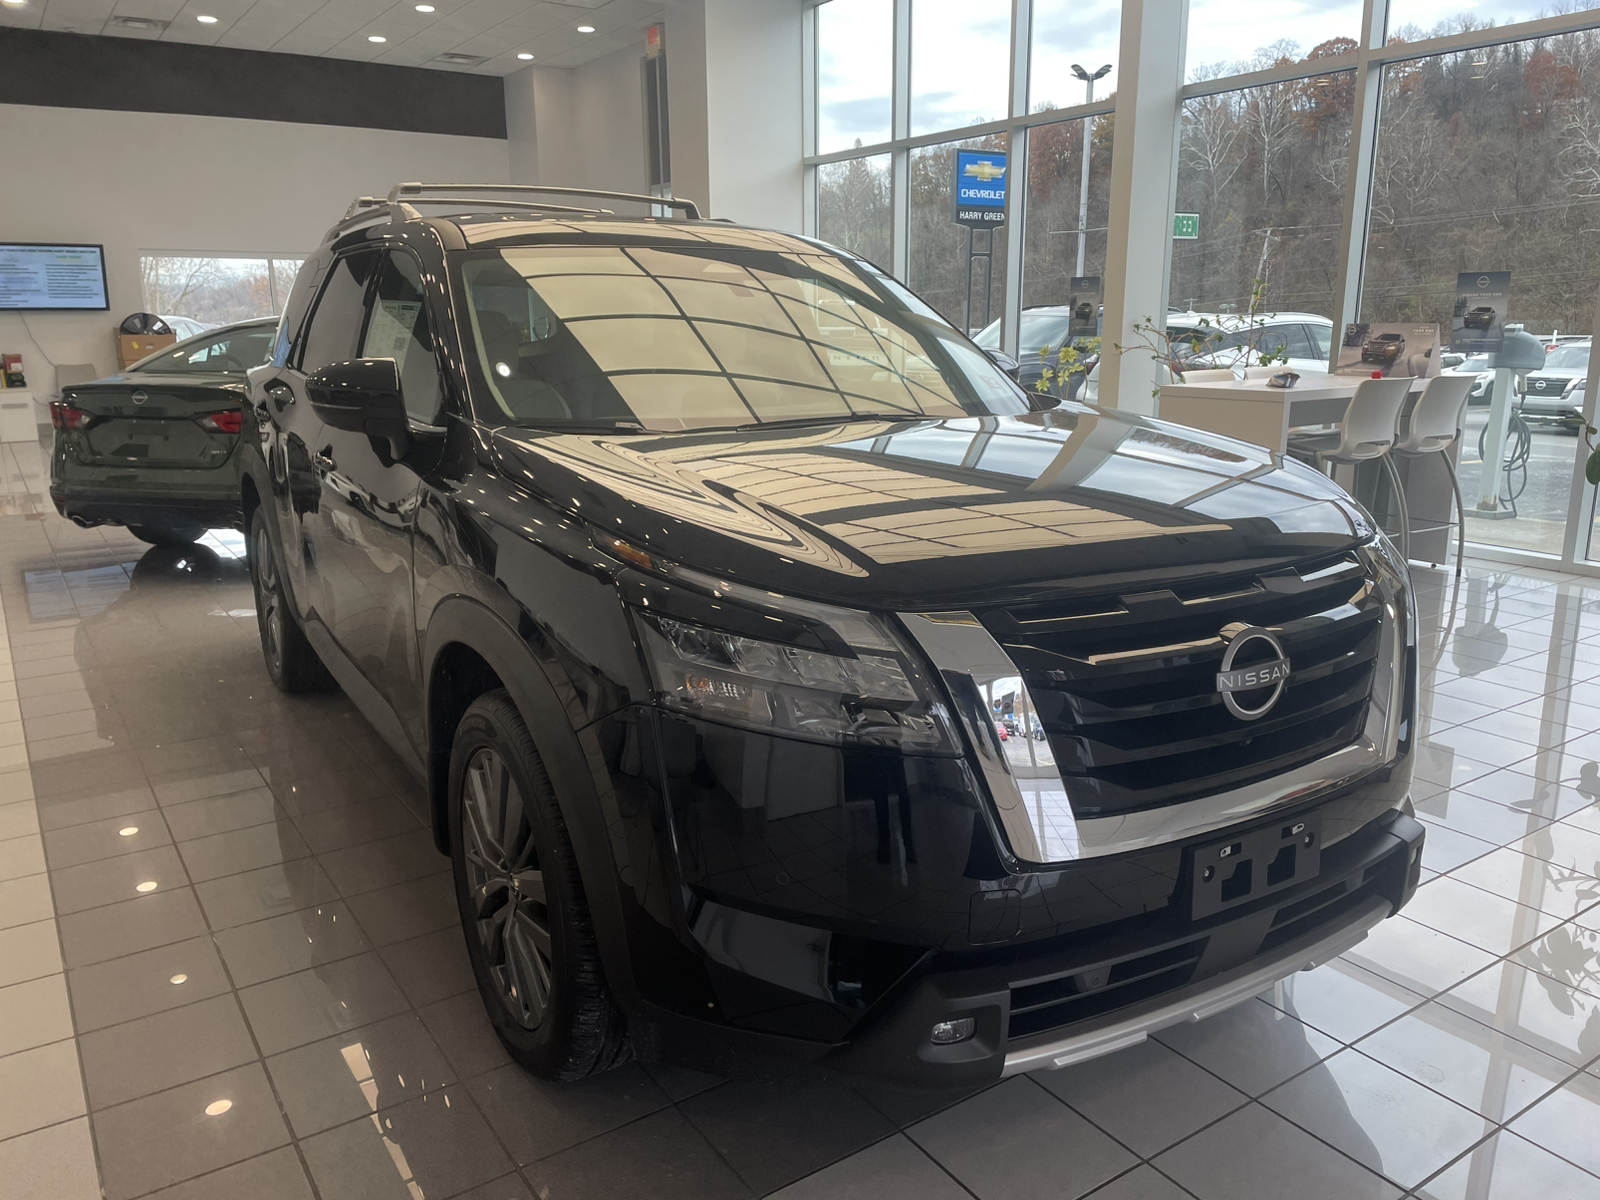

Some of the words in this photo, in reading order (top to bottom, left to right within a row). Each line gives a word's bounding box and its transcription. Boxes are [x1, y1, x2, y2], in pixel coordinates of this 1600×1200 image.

[961, 188, 1005, 199] CHEVROLET
[959, 211, 982, 220] HARRY
[984, 211, 1004, 221] GREEN
[1173, 214, 1198, 237] REEN
[1219, 661, 1290, 689] NISSAN
